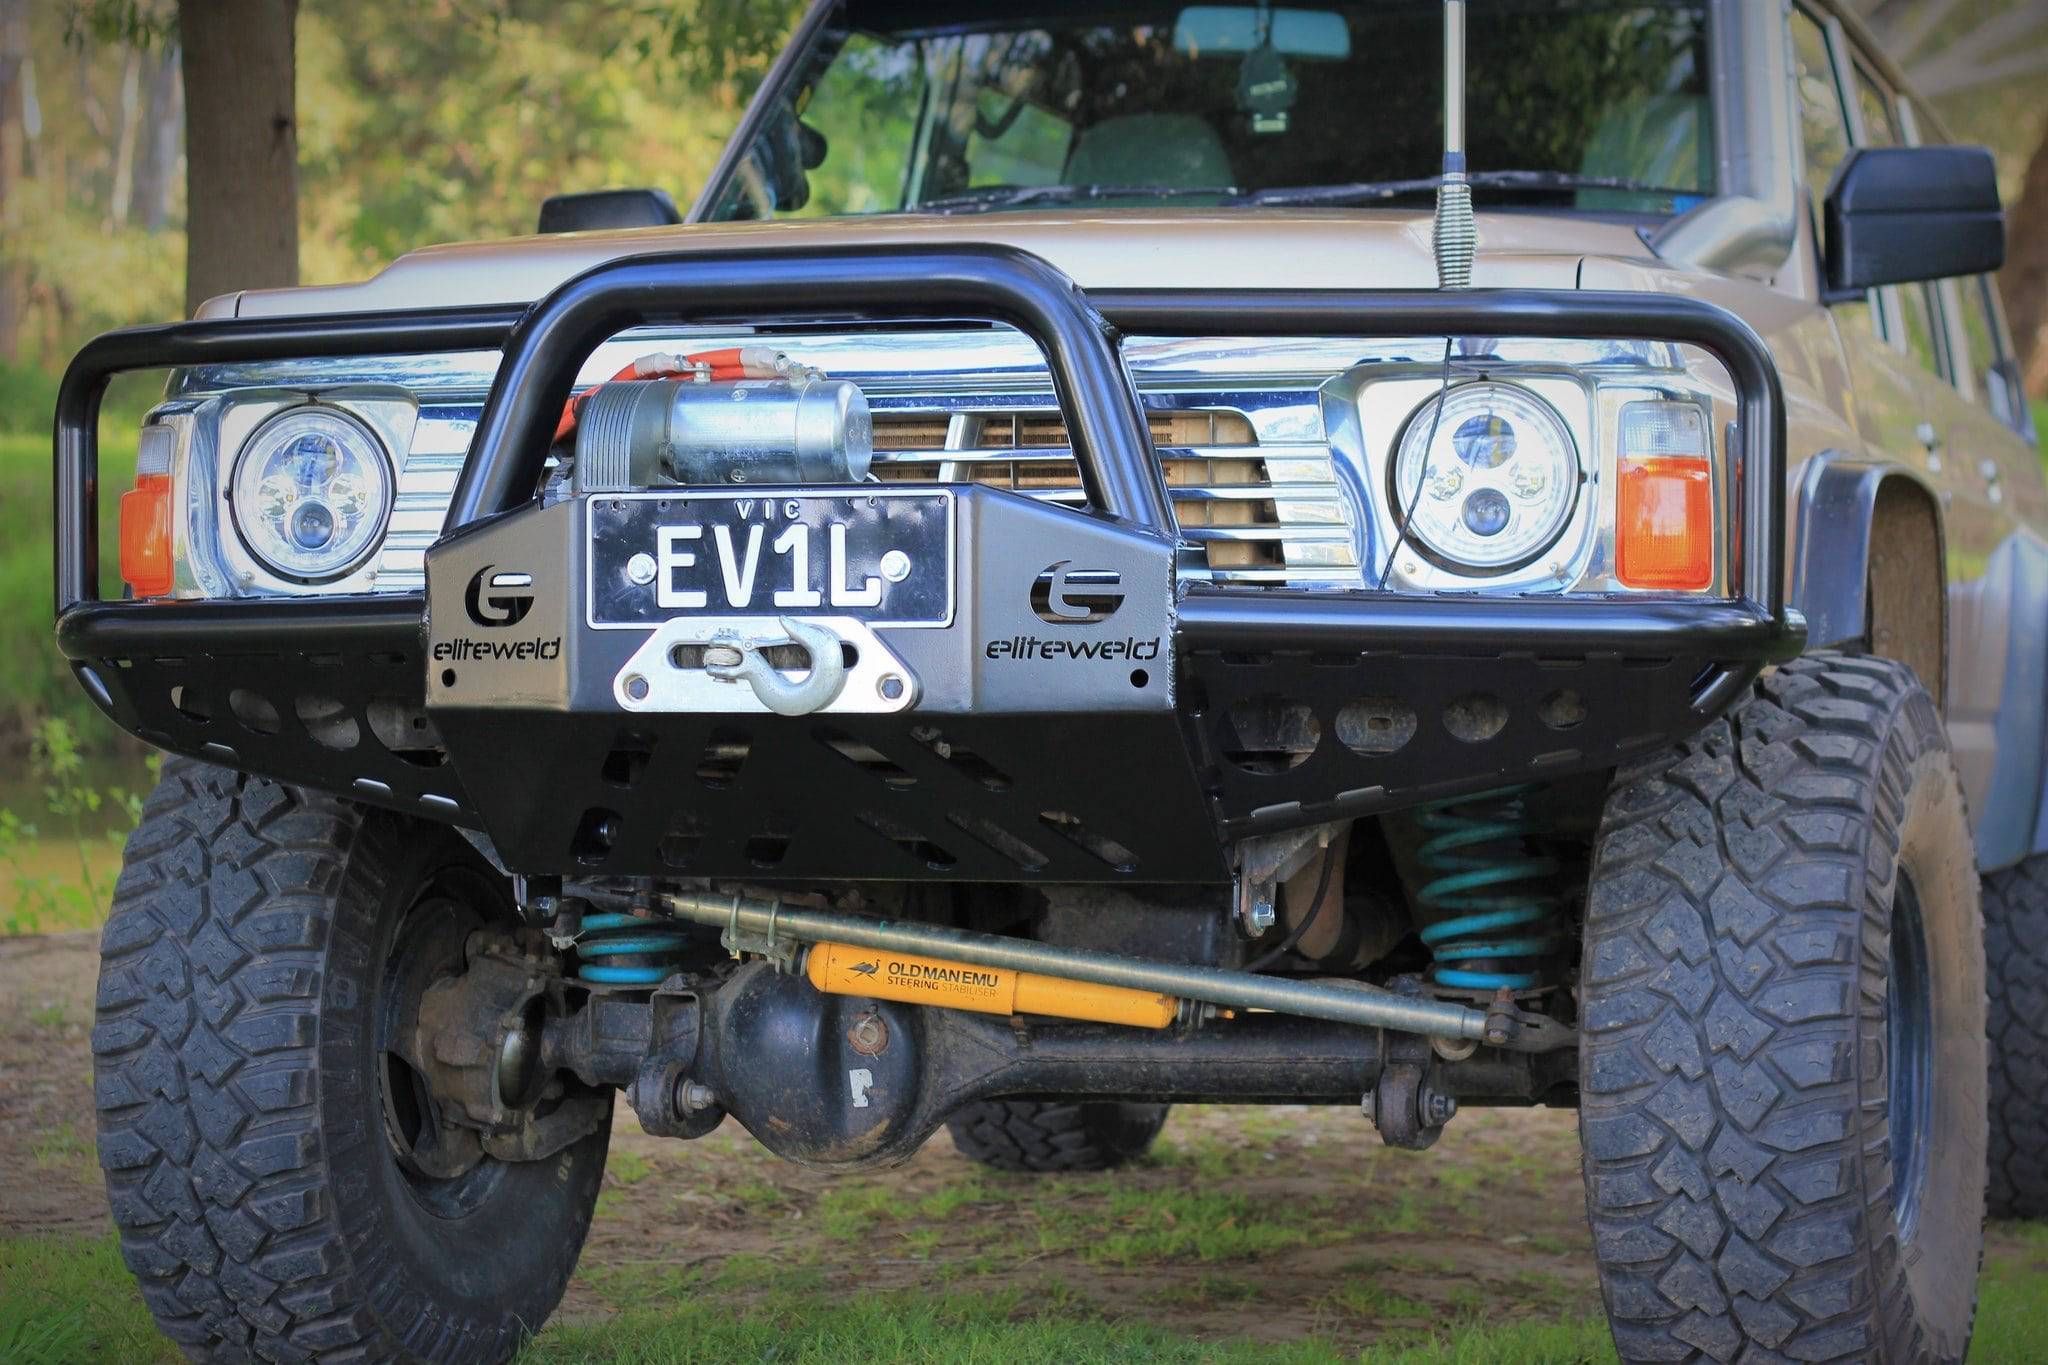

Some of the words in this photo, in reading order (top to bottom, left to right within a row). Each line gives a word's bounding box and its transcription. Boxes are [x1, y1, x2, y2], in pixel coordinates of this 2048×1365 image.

[734, 499, 801, 520] VIC
[656, 523, 883, 608] EV1L
[433, 637, 561, 660] eliteweld
[986, 636, 1160, 660] eliteweld
[888, 961, 922, 978] OLD
[923, 966, 960, 983] MAN
[961, 971, 998, 988] EMU
[887, 976, 939, 991] STEERING
[942, 982, 997, 998] STABILISER
